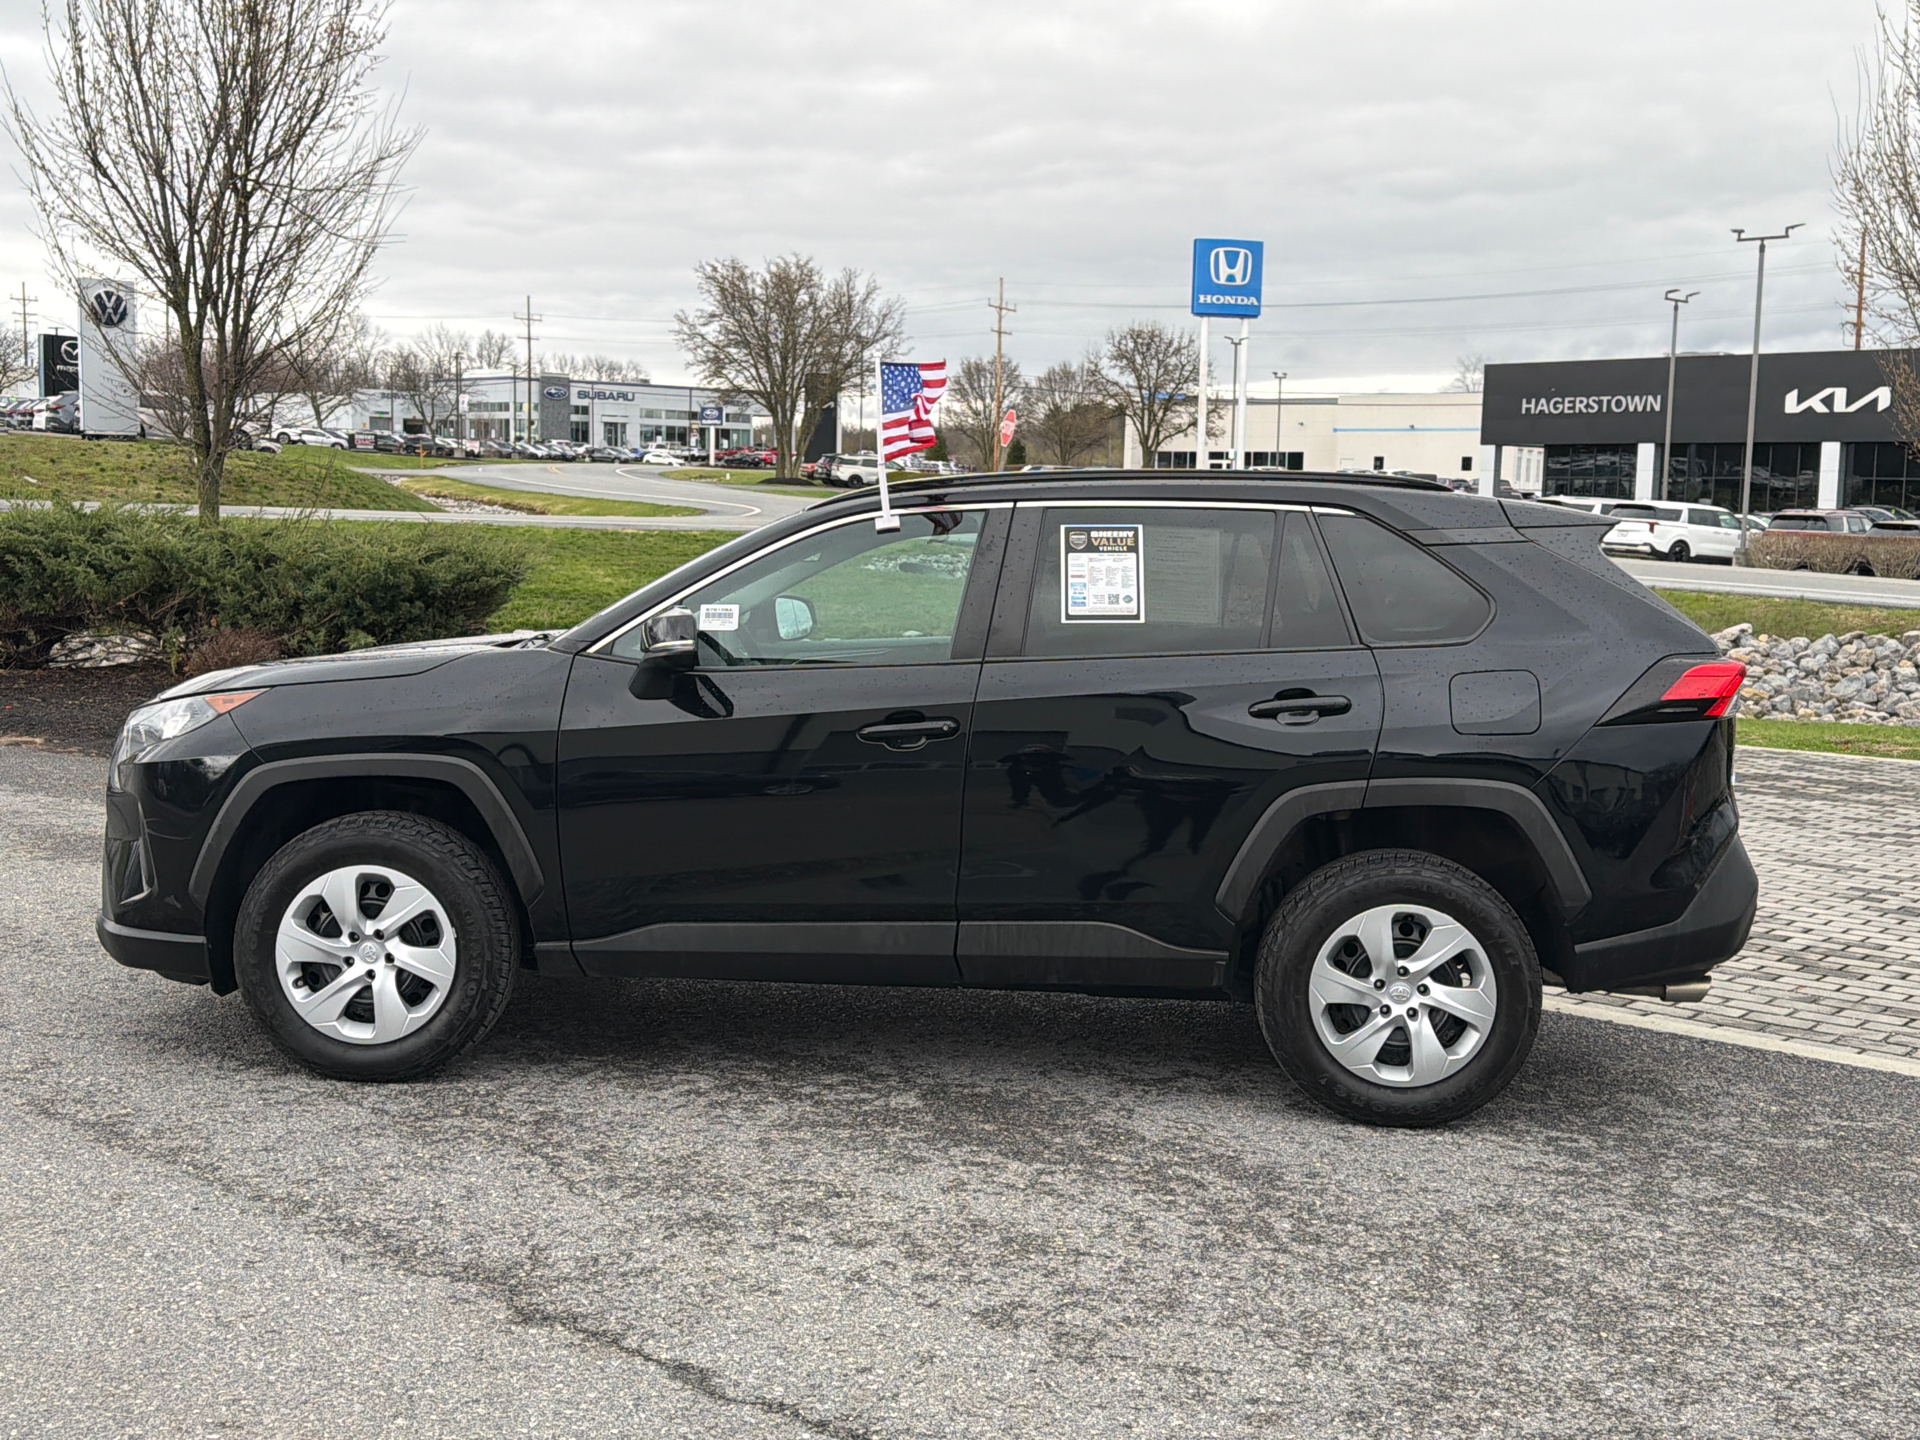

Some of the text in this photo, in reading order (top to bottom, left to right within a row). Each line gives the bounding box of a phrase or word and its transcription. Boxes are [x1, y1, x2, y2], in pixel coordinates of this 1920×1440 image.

[1198, 294, 1259, 306] HONDA
[56, 364, 79, 373] maz
[381, 392, 414, 400] SERVIC
[577, 390, 635, 402] SUBARU
[1784, 386, 1892, 414] KIA
[1521, 394, 1662, 415] HAGERSTOWN
[1091, 537, 1136, 546] VALUE
